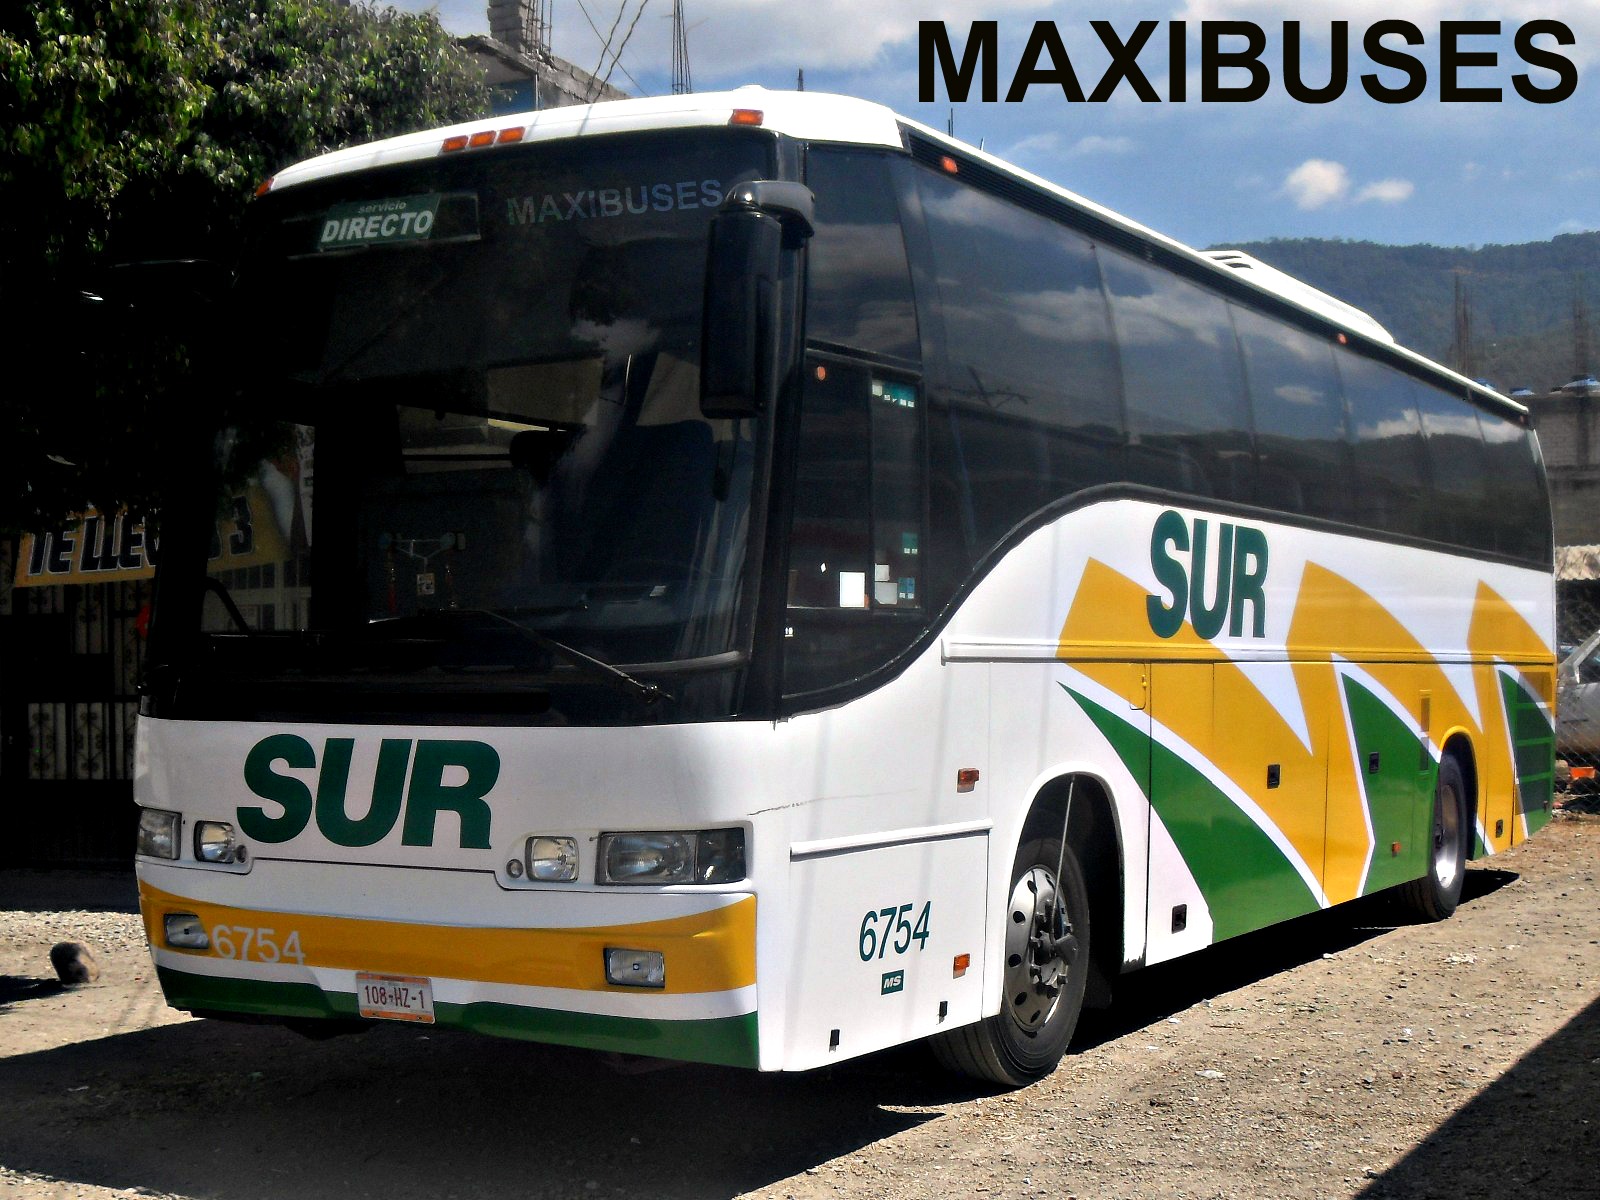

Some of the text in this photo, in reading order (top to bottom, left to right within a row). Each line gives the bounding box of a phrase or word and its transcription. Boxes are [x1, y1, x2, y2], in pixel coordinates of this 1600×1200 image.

[358, 201, 407, 213] servicio
[321, 210, 433, 242] DIRECTO
[1146, 510, 1269, 640] SUR
[236, 733, 501, 850] SUR
[211, 924, 306, 965] 6754
[859, 901, 931, 962] 6754
[364, 985, 425, 1009] 108-HZ-1
[883, 975, 902, 989] MS
